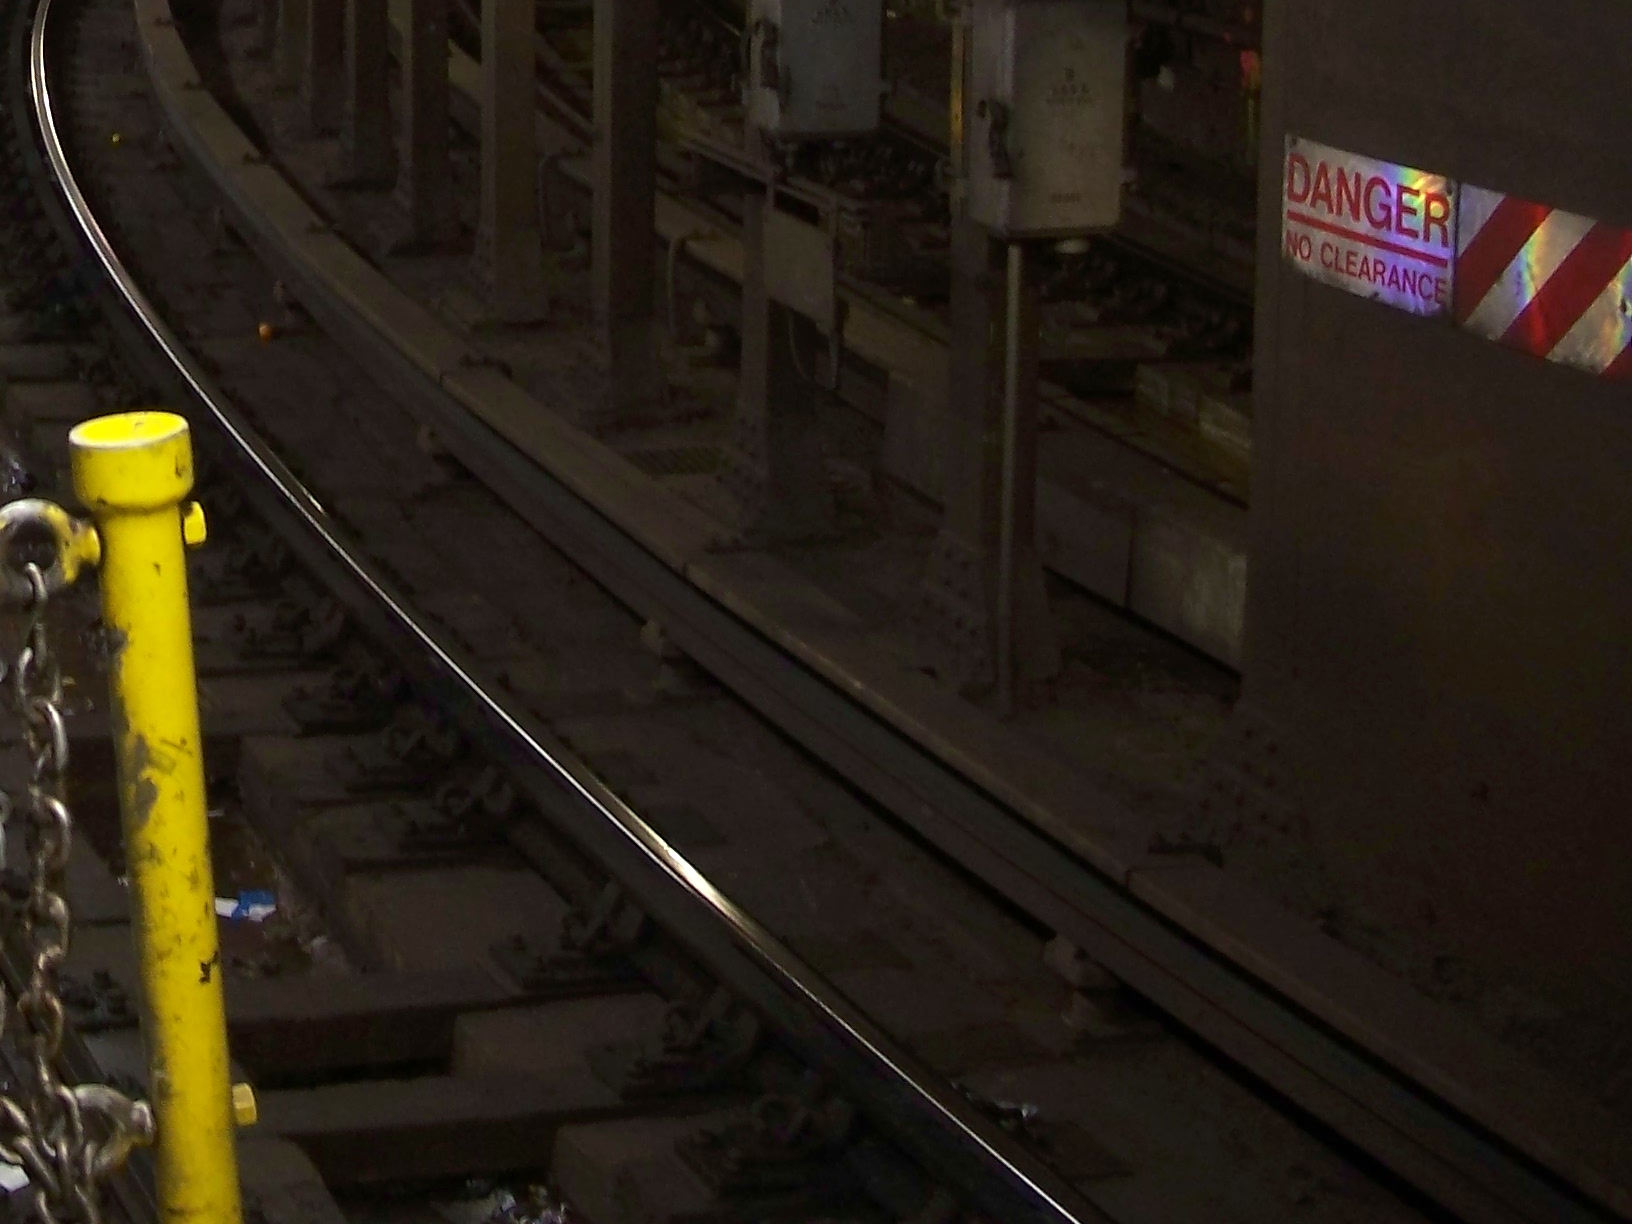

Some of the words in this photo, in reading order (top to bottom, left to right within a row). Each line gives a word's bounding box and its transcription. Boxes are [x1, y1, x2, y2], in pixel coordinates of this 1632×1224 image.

[1286, 152, 1450, 248] DANGER
[1285, 229, 1312, 262] NO
[1320, 241, 1447, 304] CLEARANCE
